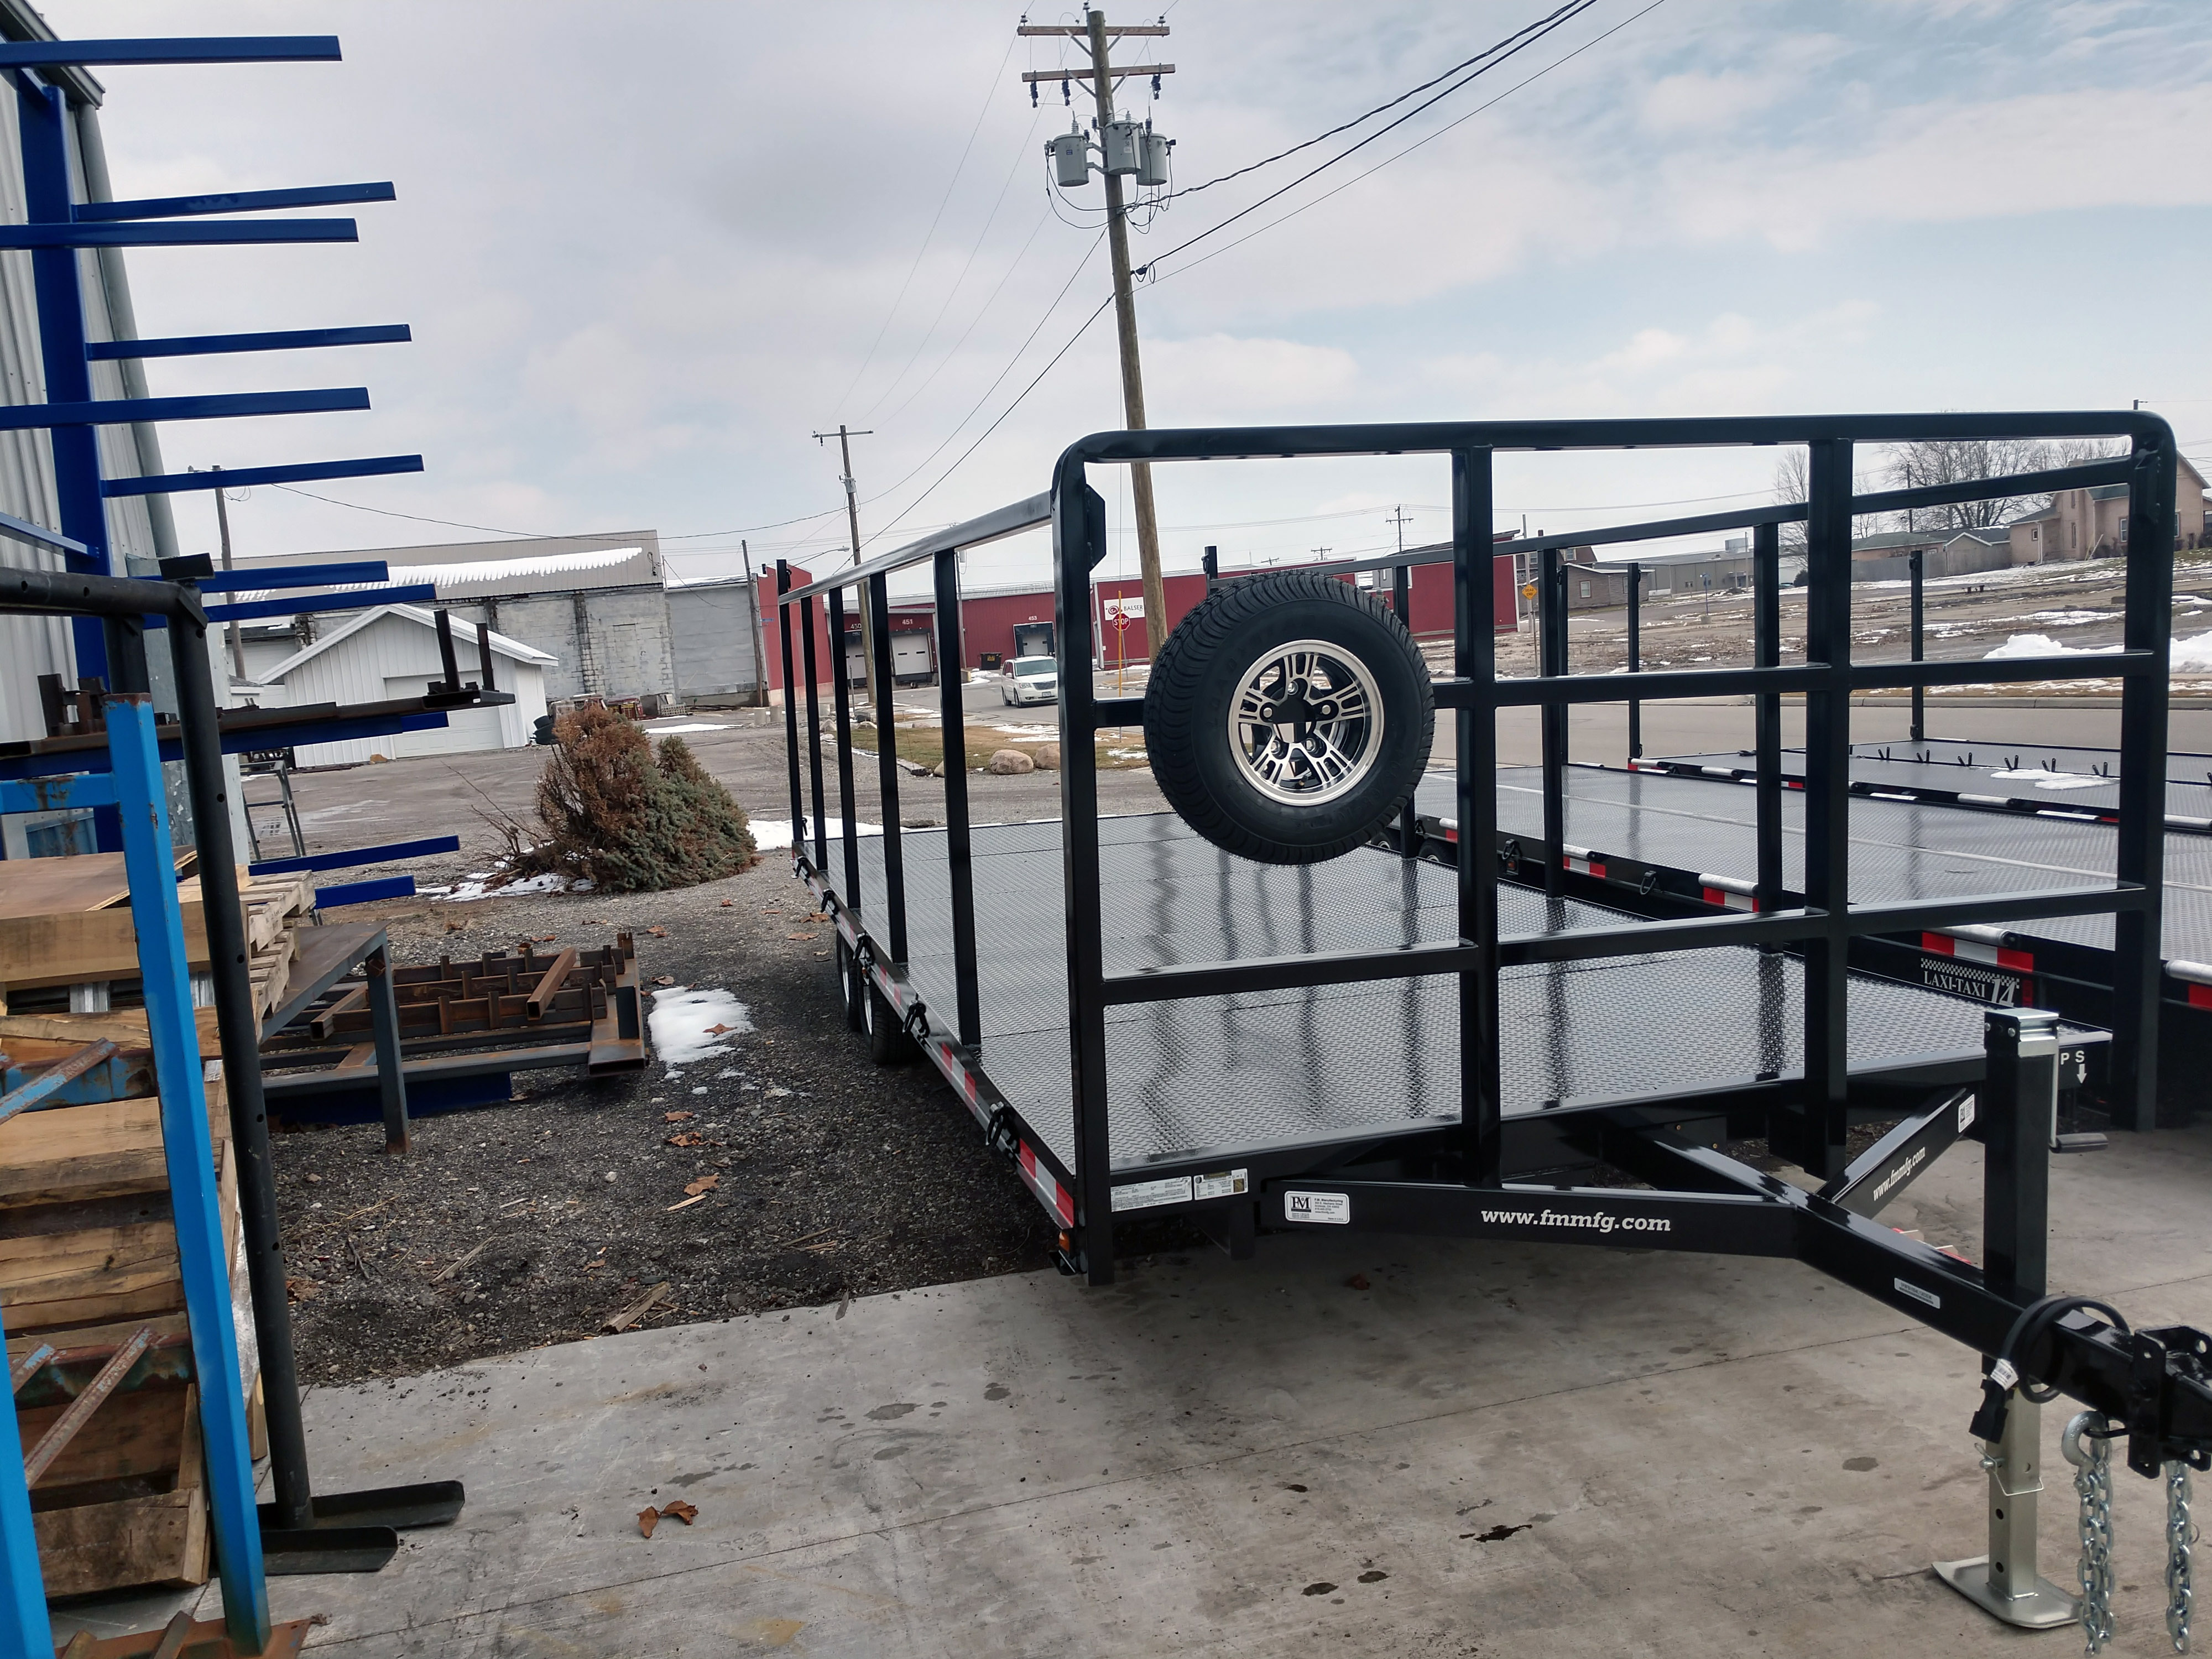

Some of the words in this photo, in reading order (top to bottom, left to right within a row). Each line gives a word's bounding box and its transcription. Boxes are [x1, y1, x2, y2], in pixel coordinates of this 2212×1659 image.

[1114, 618, 1129, 626] SOP
[1924, 971, 1986, 998] LAXI-TAXI
[1991, 978, 2016, 1007] 14
[2060, 1052, 2070, 1066] P
[2075, 1050, 2085, 1063] S
[1873, 1146, 1925, 1201] www.fmmfg.com
[1481, 1209, 1671, 1233] www.fmmfg.com
